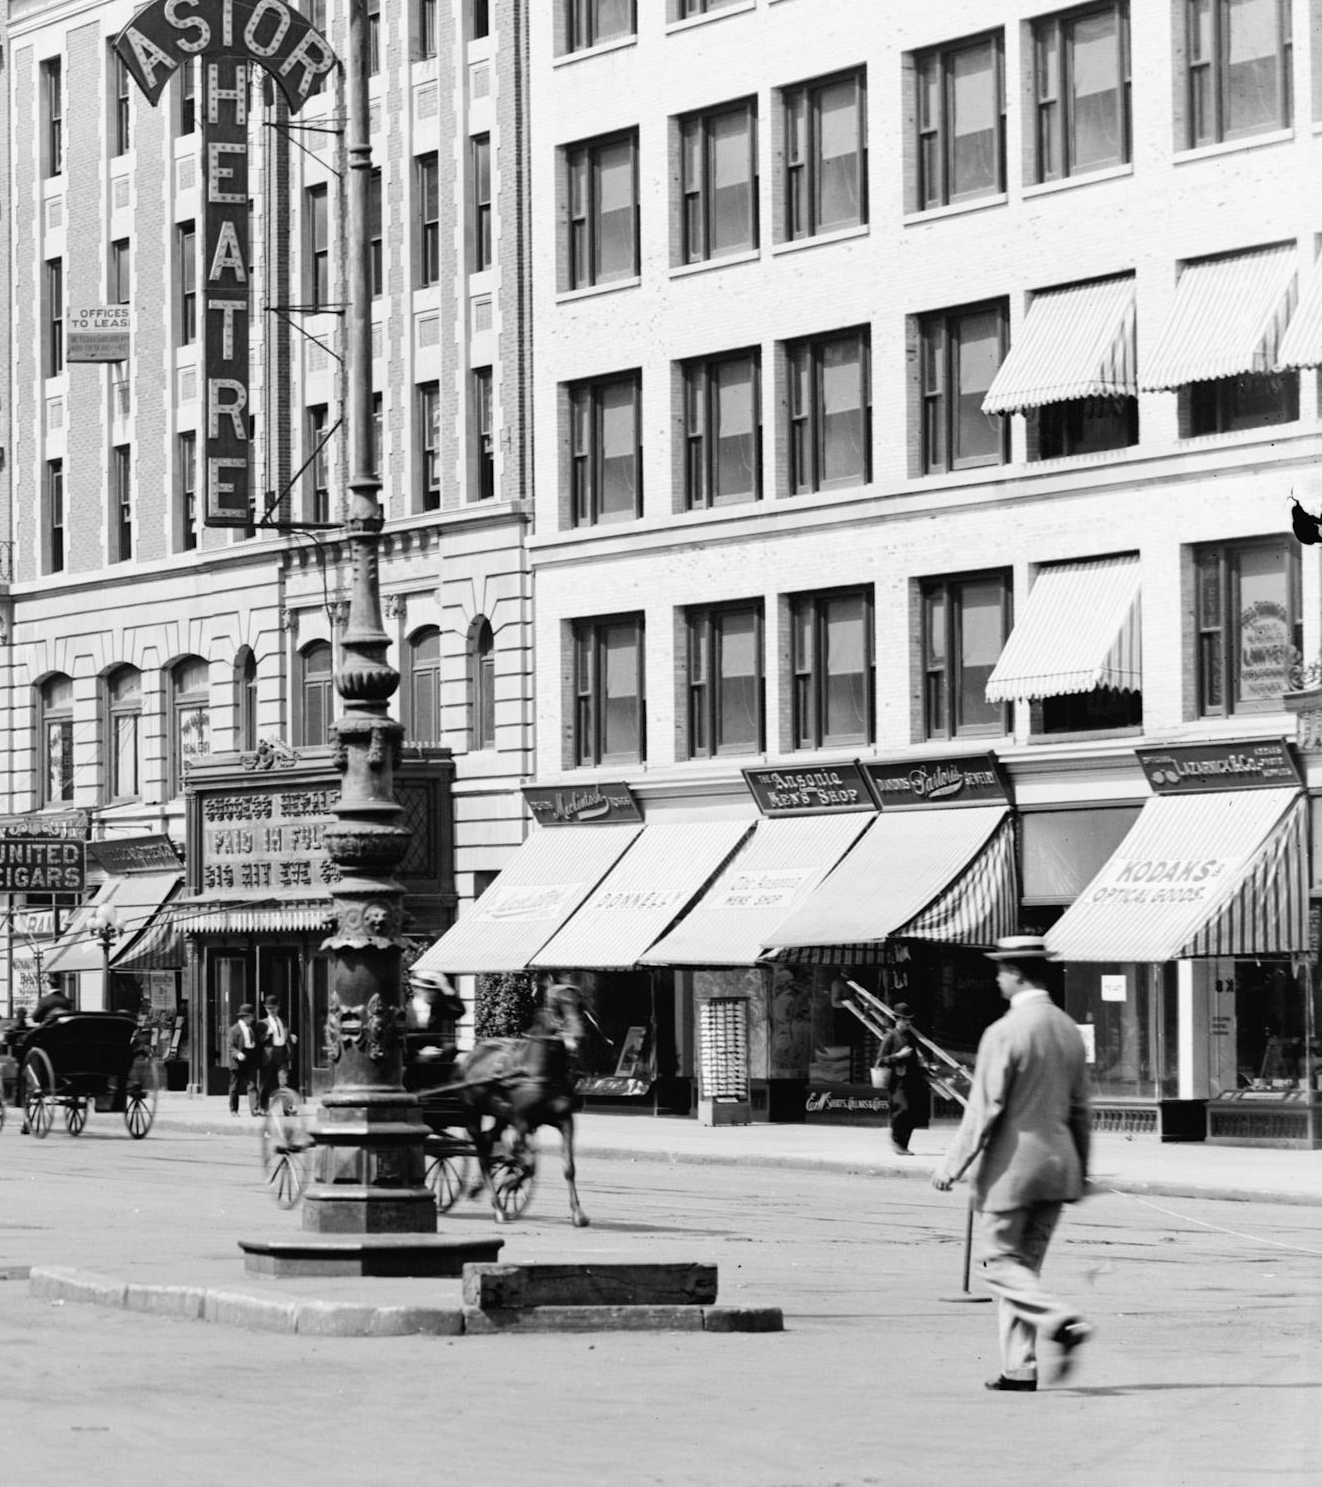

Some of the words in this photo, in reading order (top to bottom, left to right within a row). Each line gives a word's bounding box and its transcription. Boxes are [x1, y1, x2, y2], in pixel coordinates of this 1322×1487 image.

[71, 318, 89, 328] TO
[94, 318, 130, 328] LEAS
[79, 308, 129, 319] OFFICES
[757, 774, 772, 785] THE
[772, 767, 844, 791] Ansonia
[816, 788, 858, 805] SHOP
[293, 825, 325, 851] FUL
[1116, 859, 1218, 883] KODAKS
[594, 888, 690, 911] DONNELLY
[1092, 886, 1148, 904] OPTICAL
